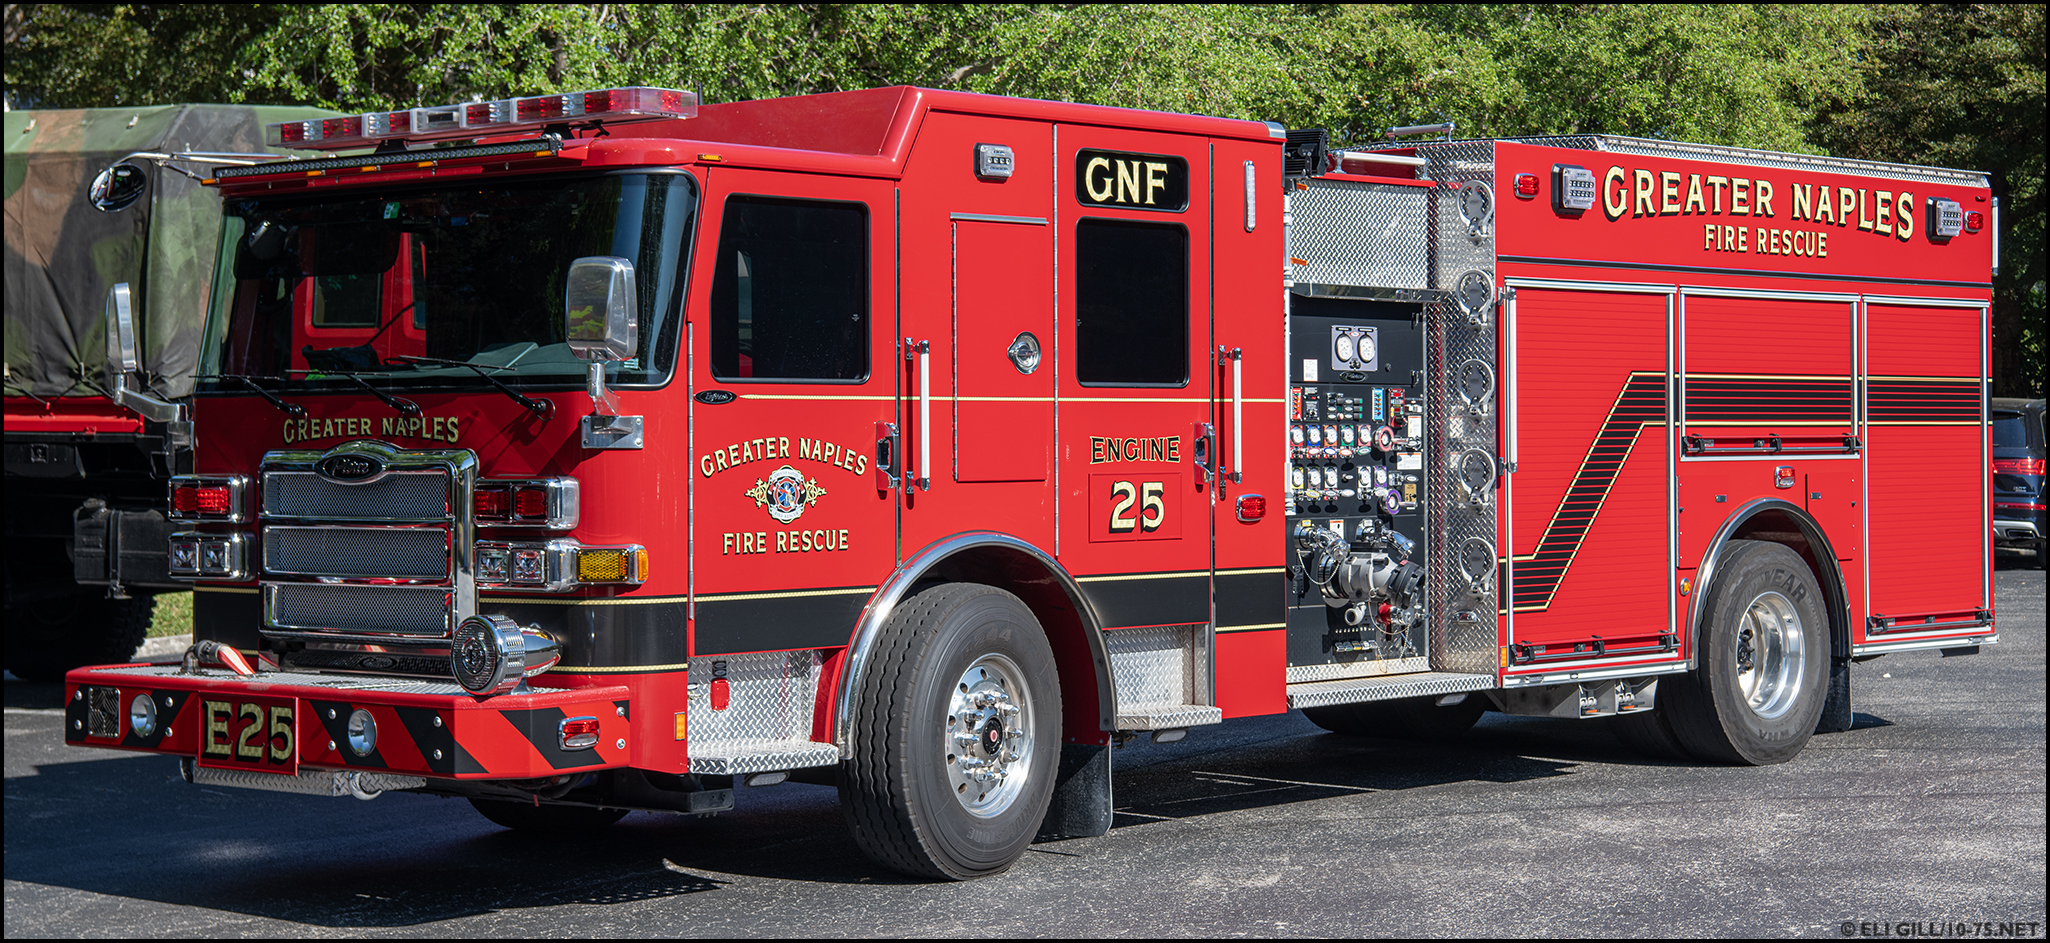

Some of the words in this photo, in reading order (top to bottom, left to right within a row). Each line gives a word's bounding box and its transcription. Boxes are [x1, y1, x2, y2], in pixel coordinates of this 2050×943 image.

[1085, 157, 1168, 204] GNF
[1602, 165, 1775, 222] GREATER
[1790, 182, 1915, 243] NAPLES
[1703, 223, 1748, 253] FIRE
[1756, 227, 1828, 258] RESCUE
[283, 418, 372, 444] GREATER
[381, 416, 459, 443] NAPLES
[1089, 435, 1181, 465] ENGINE
[700, 436, 790, 478] GREATER
[799, 437, 868, 476] NAPLES
[1109, 480, 1165, 534] 25
[722, 532, 767, 555] FIRE
[776, 529, 849, 553] RESCUE
[201, 700, 294, 766] E25
